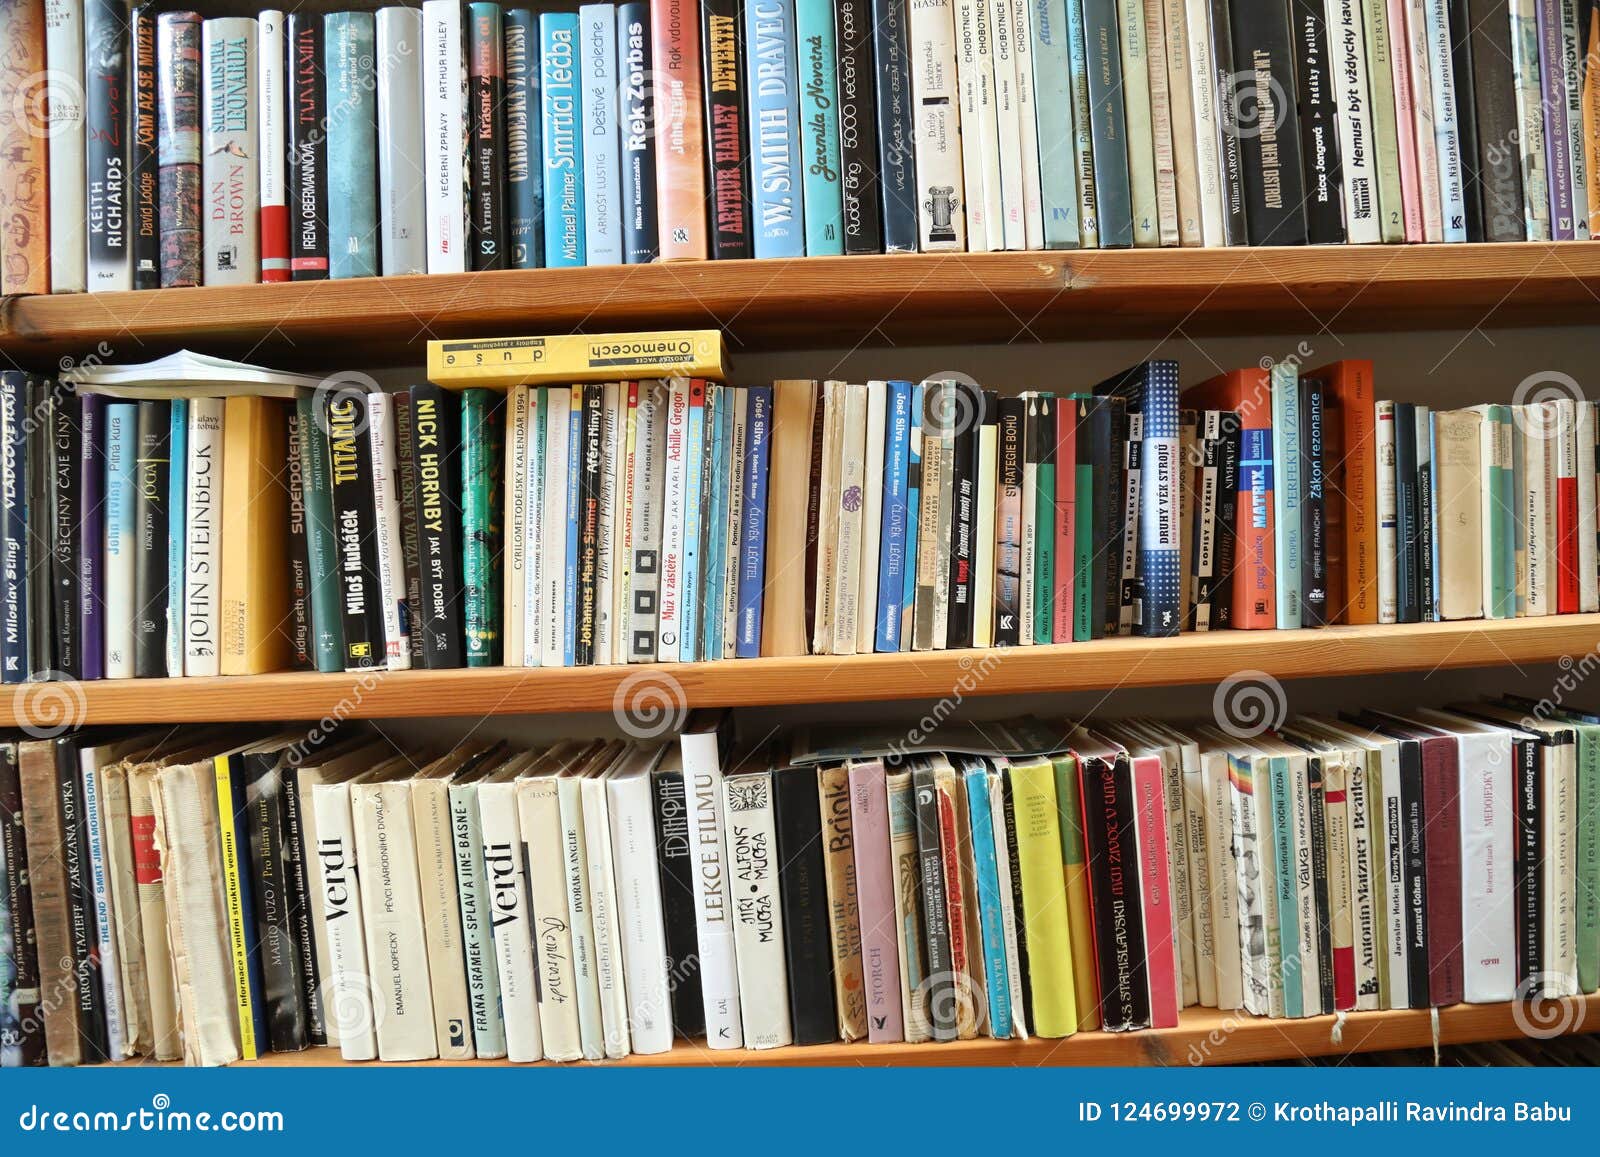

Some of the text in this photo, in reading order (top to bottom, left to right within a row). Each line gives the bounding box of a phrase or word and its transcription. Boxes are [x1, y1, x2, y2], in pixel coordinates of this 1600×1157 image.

[669, 47, 681, 69] Rok
[710, 15, 737, 92] DETEKTIV
[755, 2, 787, 96] DRAVEC
[961, 5, 972, 63] CHOBOTNICE
[997, 2, 1009, 60] CHOBOTNICE
[228, 38, 247, 132] LEONARDA
[439, 59, 447, 100] ARTHUR
[545, 30, 574, 168] Smrtící léčba
[592, 22, 606, 135] Deštivé poledne
[626, 22, 647, 150] Řek Zorbas
[806, 36, 837, 182] Jarmila Novotná
[1342, 28, 1365, 167] Nemusí být vždycky
[670, 122, 685, 154] John
[714, 104, 740, 162] HAILEY
[759, 108, 791, 193] SMITH
[1313, 127, 1328, 202] Erica Jongová
[107, 157, 121, 247] RICHARDS
[139, 173, 153, 235] David Lodge
[212, 182, 224, 220] DAN
[230, 165, 244, 234] BROWN
[300, 142, 316, 249] IRENA OBERMANNOVÁ
[480, 148, 492, 234] Arnošt Lustig
[715, 168, 743, 233] ARTHUR
[843, 104, 862, 235] Rudolf Bing 5000
[1082, 151, 1094, 209] John Irving
[1227, 135, 1241, 214] William SAROYAN
[1559, 191, 1567, 208] EVA
[1575, 165, 1584, 186] JAN
[91, 182, 103, 233] KEITH
[560, 172, 577, 259] Michael Palmer
[635, 207, 643, 229] Nikos
[761, 197, 792, 226] W.
[517, 393, 525, 414] 1994
[753, 396, 765, 444] José Silva
[895, 393, 906, 440] José Silva
[1310, 393, 1321, 457] rezonance
[330, 400, 359, 485] TITANIC
[1006, 443, 1017, 497] STRATEGIE
[1285, 432, 1298, 508] PERFEKTNÍ
[56, 412, 72, 562] VŠECHNY ČAJE ČÍNY
[416, 400, 446, 619] NICK HORNBY JAK DOBRÝ
[661, 392, 685, 620] Muž zástěře Achille Gregor
[1128, 479, 1136, 521] SEKTOU
[1154, 444, 1169, 544] DRUHÝ VĚK STROJŮ
[1251, 470, 1267, 528] MATRIX
[1309, 461, 1322, 498] Zákon
[107, 523, 120, 555] John
[189, 443, 213, 645] JOHN STEINBECK
[288, 416, 304, 623] seth danoff superpotence
[580, 396, 600, 646] Johannes Mario Simmel Aféra B.
[1202, 530, 1211, 566] DOPISY
[5, 538, 18, 643] Miloslav Stingl
[341, 510, 365, 614] Miloš Hubáček
[728, 587, 738, 612] Kathryn
[826, 781, 852, 853] Brink
[1483, 771, 1493, 827] MEDOJEDKY
[85, 772, 110, 944] THE END SMRT JIMA MORRISONA
[258, 799, 282, 965] MARIO PUZO Pro blázny smrt
[317, 836, 349, 921] Verdi
[567, 830, 578, 864] ANGLIE
[693, 773, 725, 922] LEKCE FILMU
[734, 825, 752, 880] ALFONS
[1279, 836, 1290, 899] Peter Andruška
[1299, 848, 1310, 890] VÁLKA
[1351, 767, 1374, 970] Antonín Matzner Beatles
[1388, 797, 1402, 956] Jaroslav Dvorky, Plechovka
[62, 780, 93, 1010] HAROUN TAZIEFF SOPKA
[464, 893, 478, 930] SPLAV
[484, 841, 519, 927] Verdi
[755, 895, 774, 942] MUCHA
[1412, 876, 1423, 947] Leonard Cohen
[227, 872, 248, 1007] Informace struktura
[298, 915, 313, 976] HEGEROVÁ
[392, 974, 405, 1015] EMANUEL
